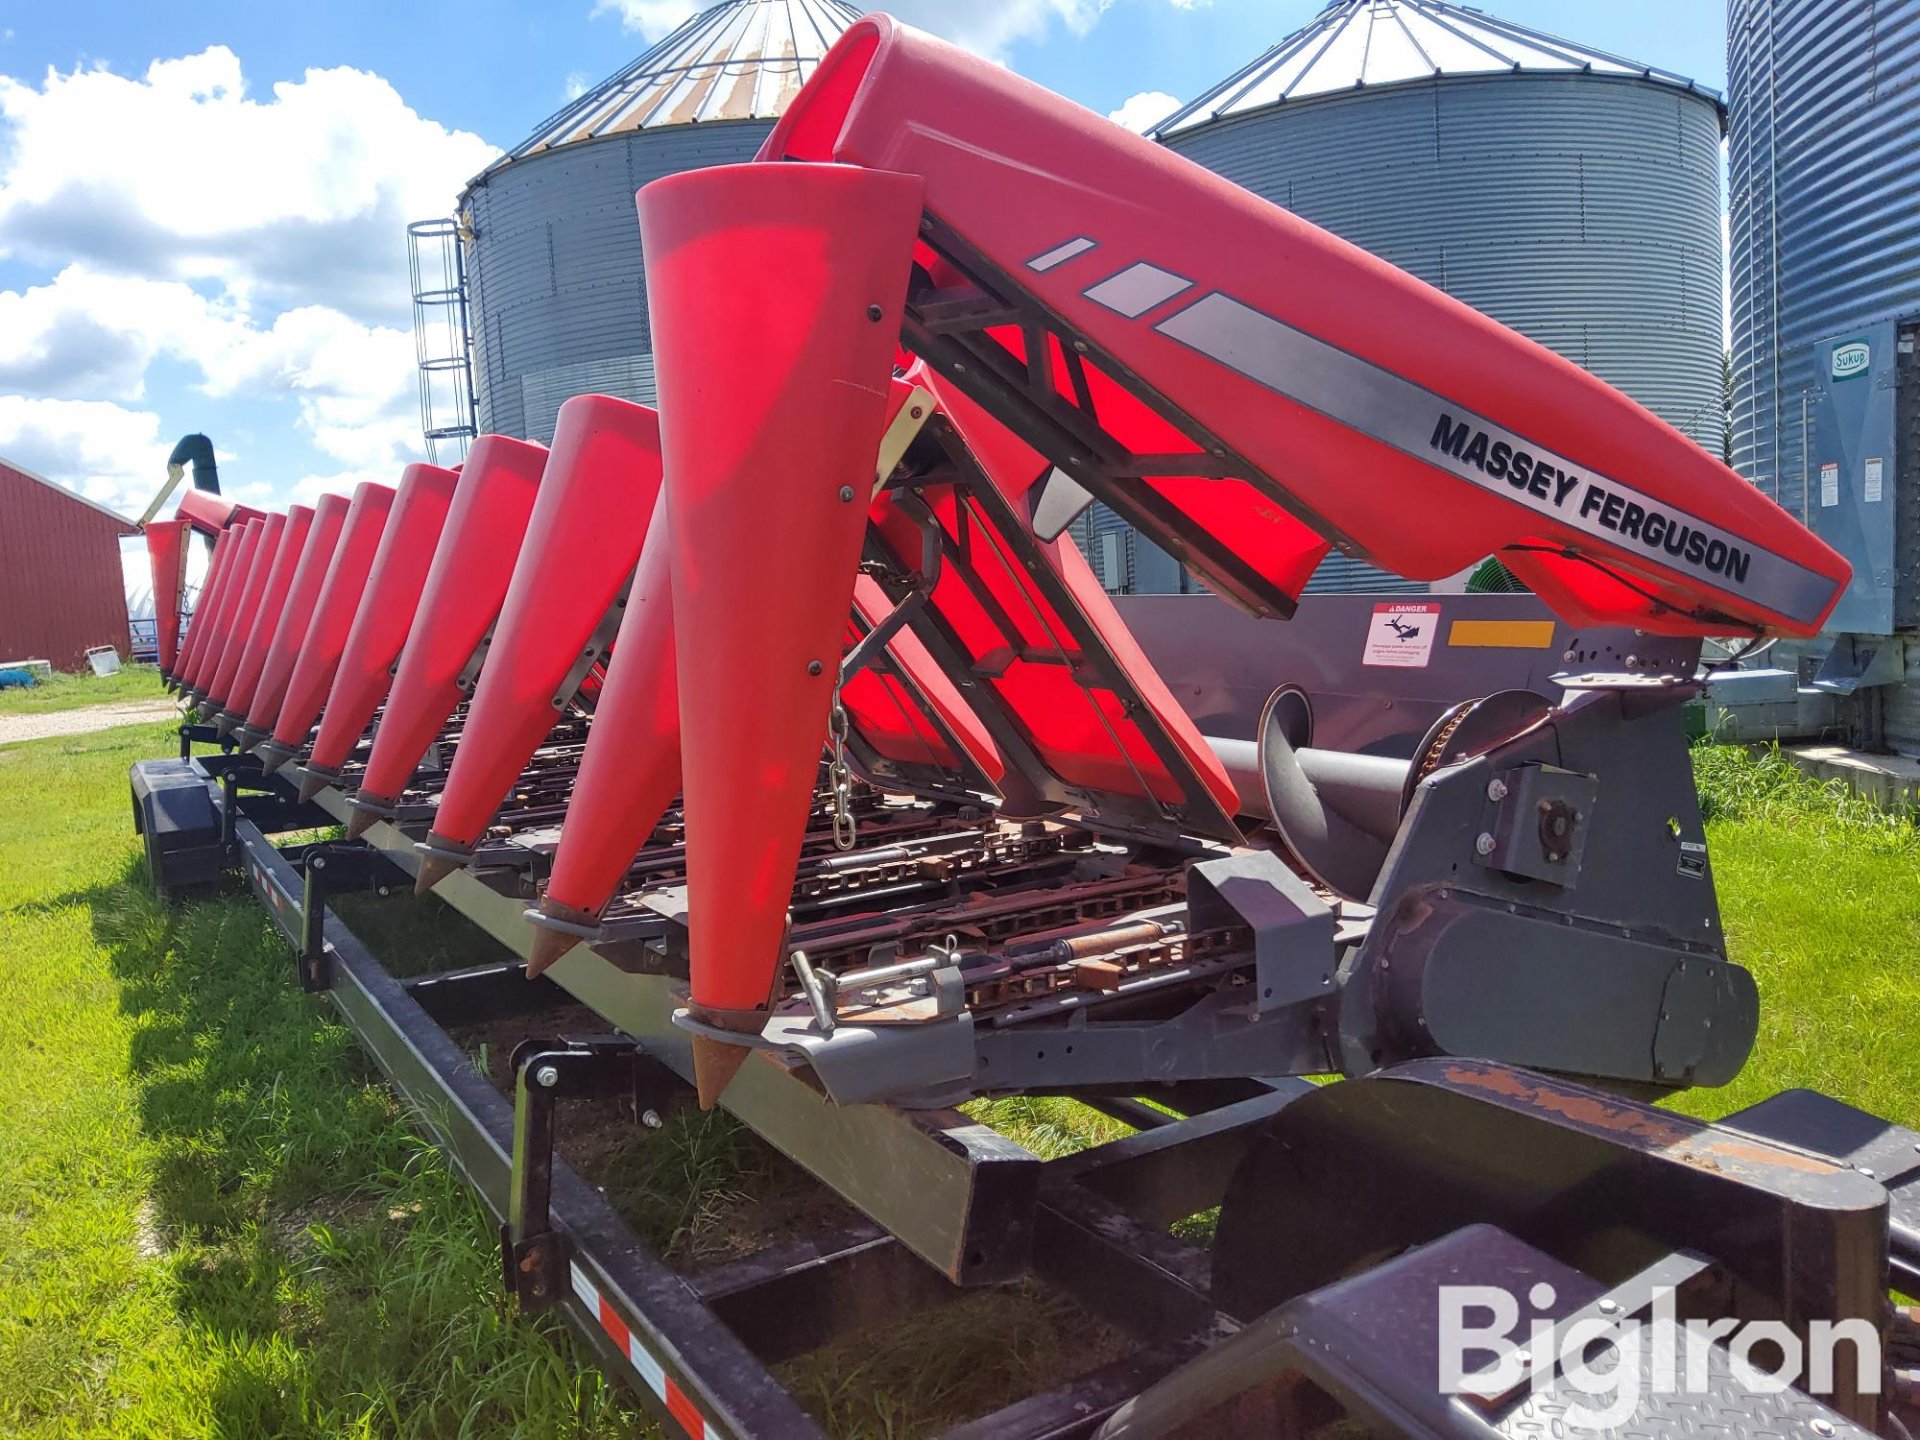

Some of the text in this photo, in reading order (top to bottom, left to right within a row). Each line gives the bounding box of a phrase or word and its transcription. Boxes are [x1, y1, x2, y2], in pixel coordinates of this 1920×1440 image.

[1836, 352, 1865, 367] Sukup
[1430, 413, 1751, 583] MASSEY FERGUSON
[1395, 605, 1427, 613] DANGER
